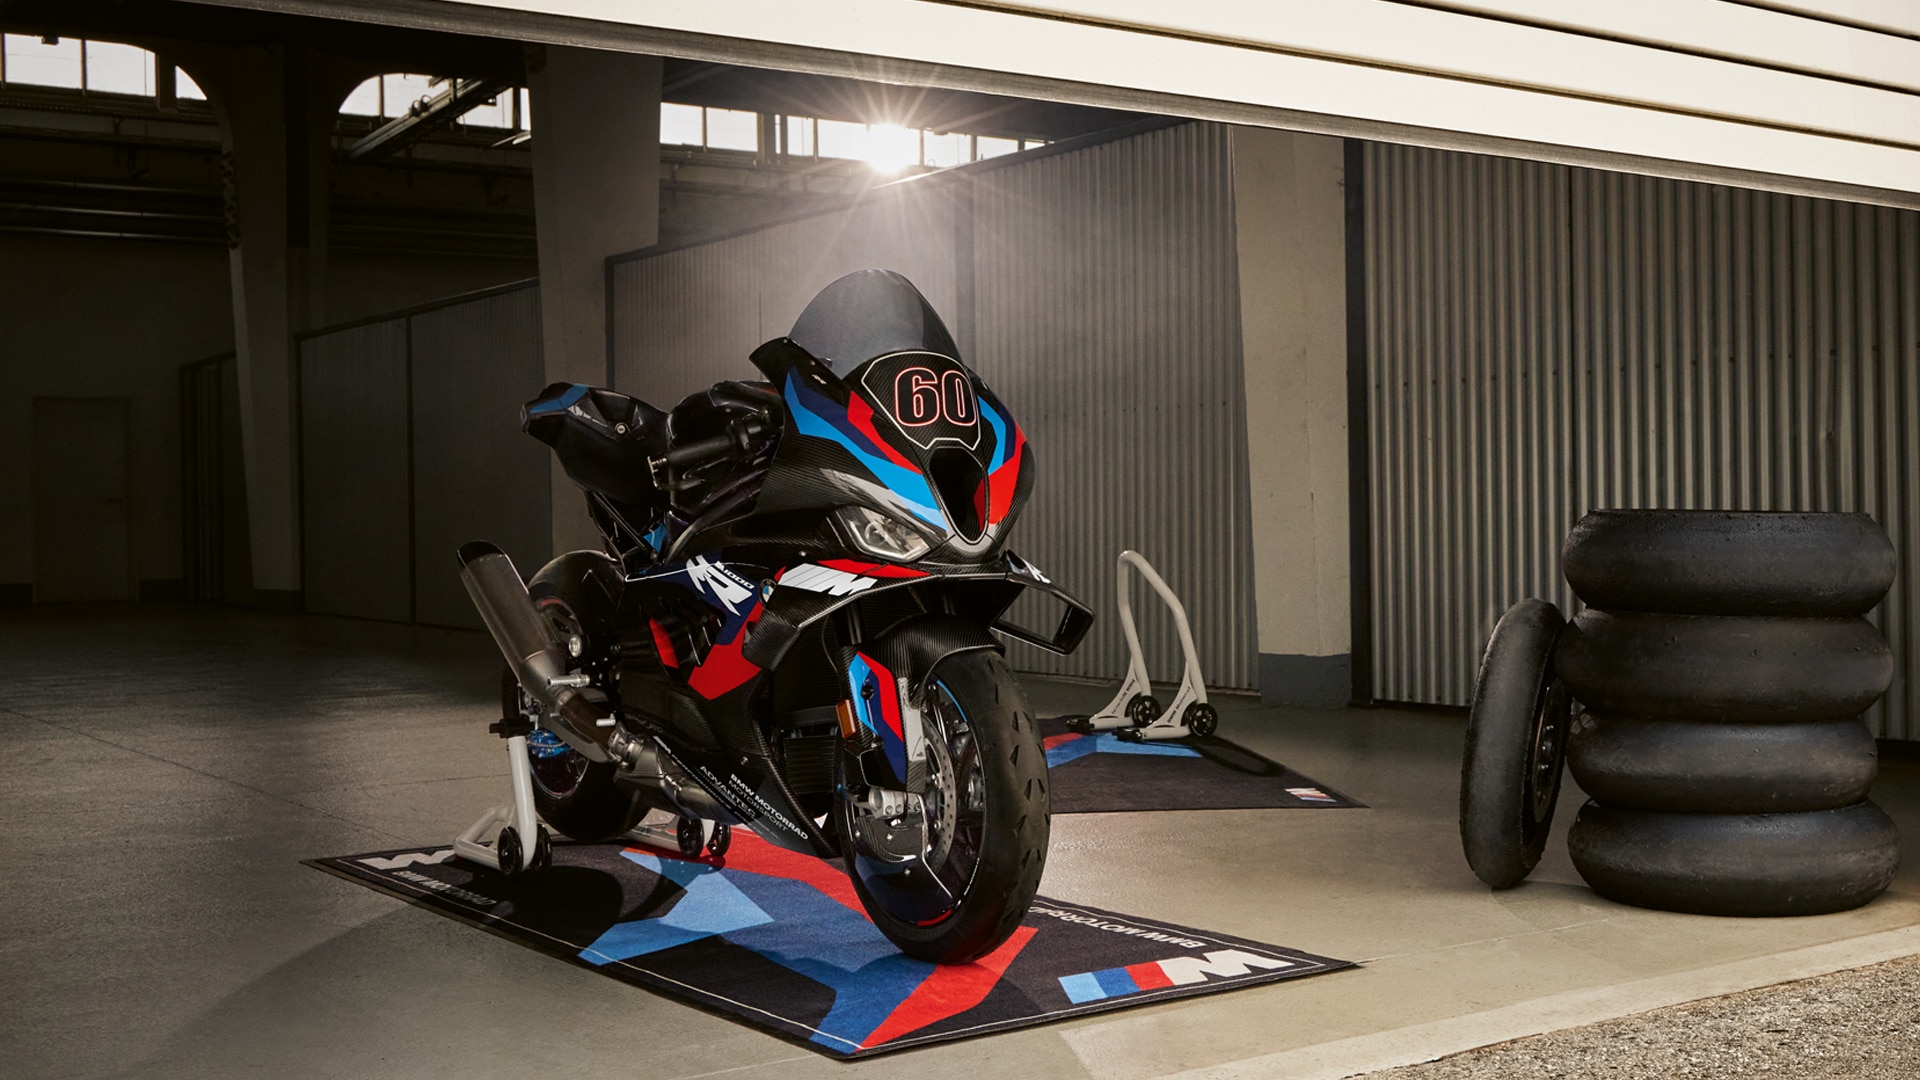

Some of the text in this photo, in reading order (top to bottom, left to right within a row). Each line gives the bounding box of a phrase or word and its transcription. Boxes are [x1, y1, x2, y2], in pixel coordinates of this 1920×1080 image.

[894, 366, 977, 427] 60
[728, 780, 788, 832] MOTORSPORT
[730, 773, 755, 797] BMW
[755, 795, 809, 840] MOTORRAD
[1136, 931, 1207, 949] BMW
